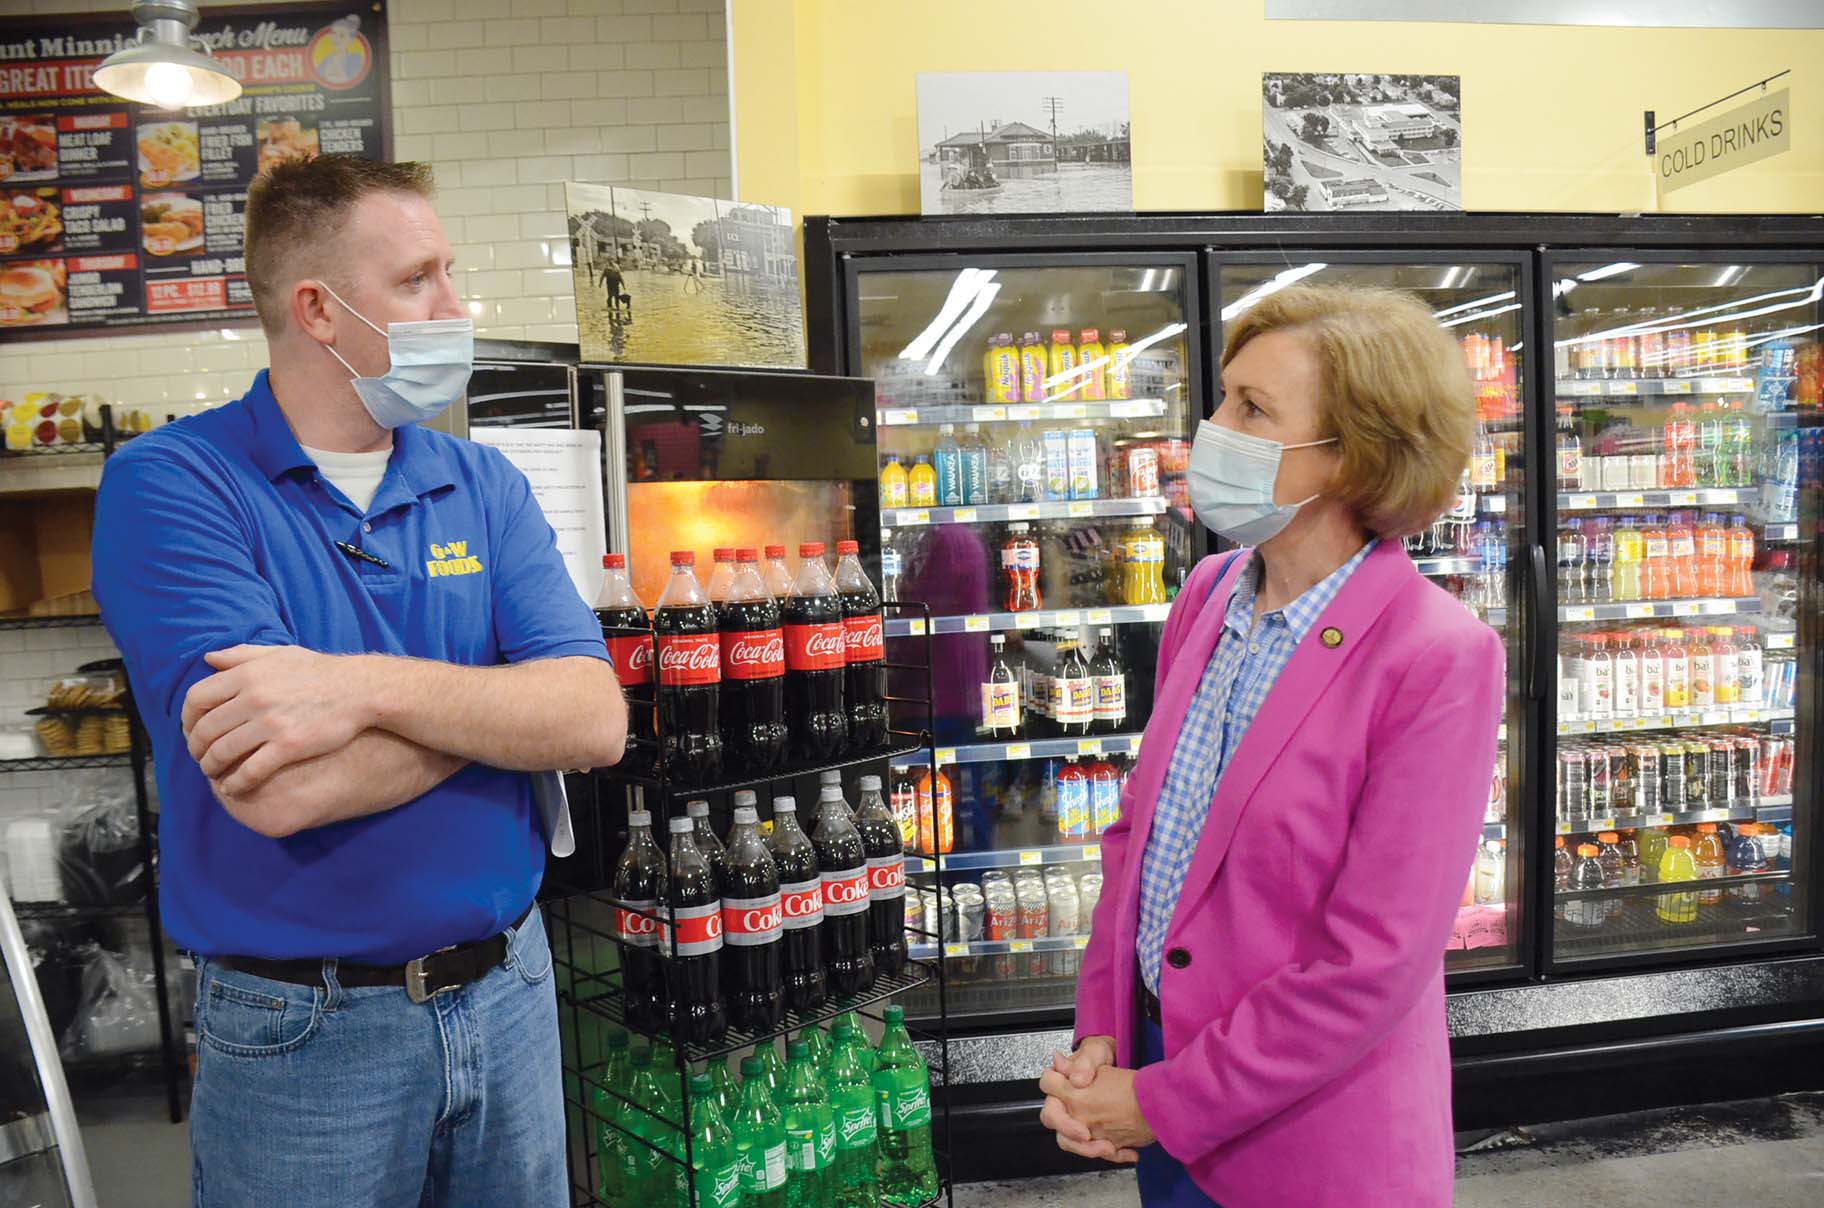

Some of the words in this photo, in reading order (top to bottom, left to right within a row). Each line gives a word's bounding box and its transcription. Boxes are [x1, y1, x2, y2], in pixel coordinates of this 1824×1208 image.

[238, 22, 309, 49] Menu
[0, 67, 59, 93] GREAT
[64, 65, 97, 90] ITE
[252, 53, 304, 79] EACH
[255, 94, 325, 114] FAVORITES
[1661, 141, 1705, 178] COLD
[1711, 109, 1783, 160] DRINKS
[727, 422, 765, 436] fri-jado
[660, 643, 720, 670] Coca-Cola
